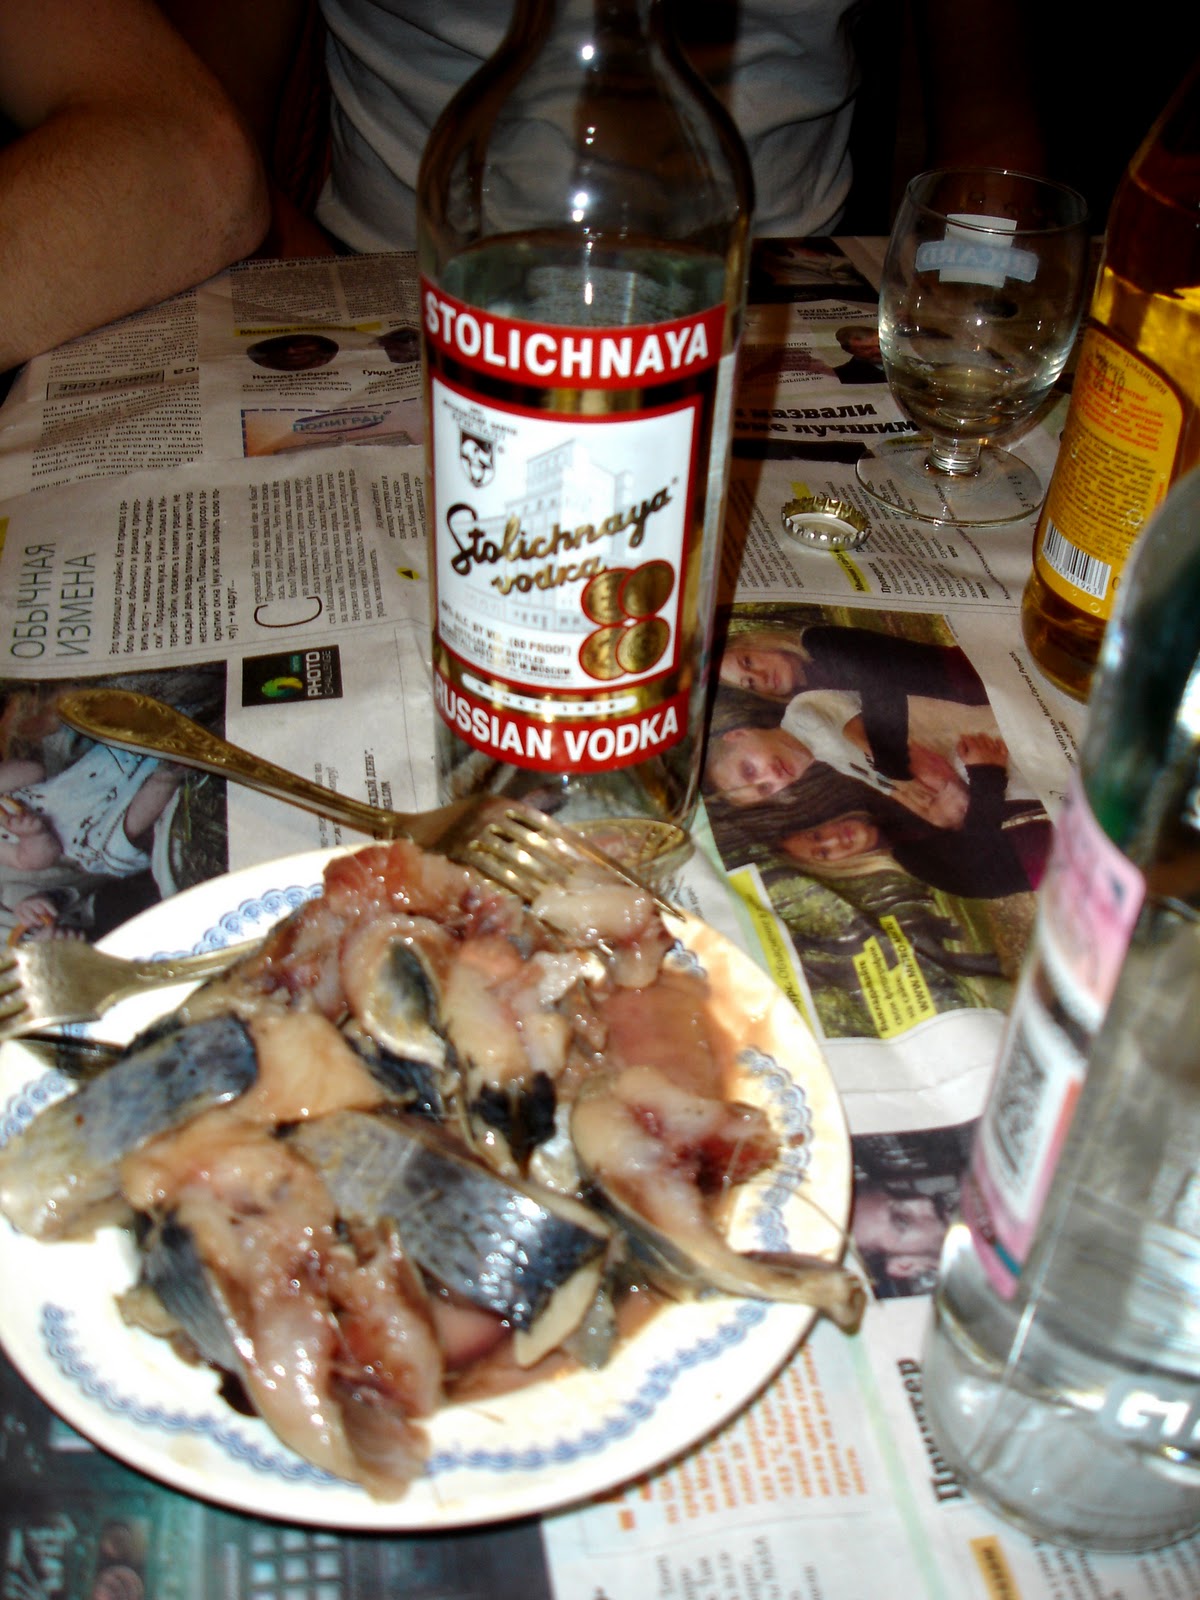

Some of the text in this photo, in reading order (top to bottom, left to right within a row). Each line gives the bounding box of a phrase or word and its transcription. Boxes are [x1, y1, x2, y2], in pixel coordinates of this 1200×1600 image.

[425, 290, 710, 380] STOLICHNAYA
[793, 421, 922, 437] лучшим
[446, 483, 673, 577] Stolichnaya
[10, 541, 56, 660] ОБЫЧНАЯ
[56, 552, 97, 658] ИЗМЕНА
[491, 556, 606, 596] vodka
[305, 651, 322, 696] PHOTO
[434, 684, 680, 763] RUSSIAN VODKA
